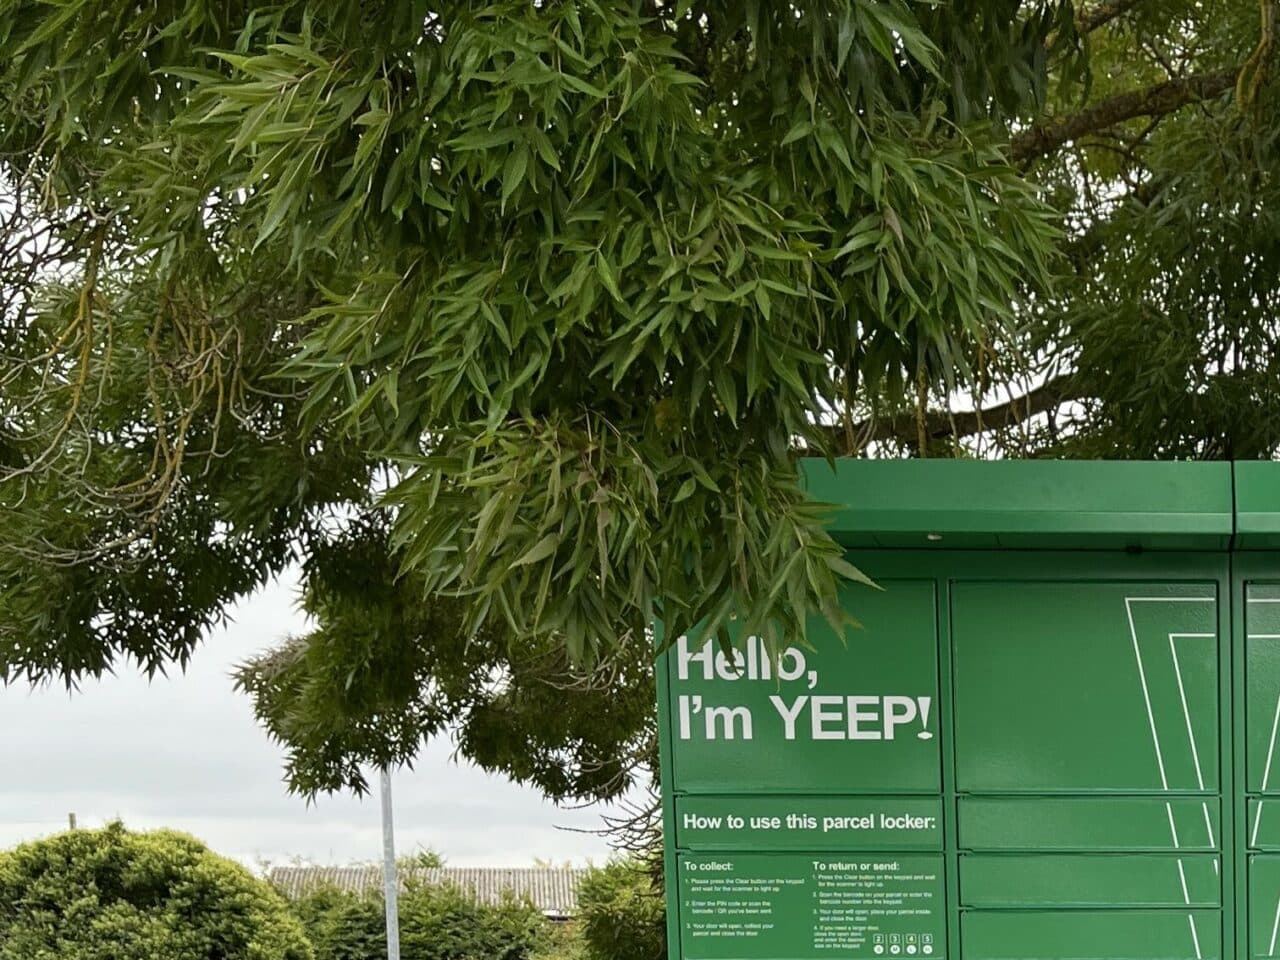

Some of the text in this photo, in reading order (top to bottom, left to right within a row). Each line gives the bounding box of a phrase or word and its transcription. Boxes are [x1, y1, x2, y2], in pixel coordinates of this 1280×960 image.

[677, 635, 818, 689] Hello,
[679, 696, 934, 740] I'm YEEP!
[684, 814, 936, 833] How to use this parcel locker:
[685, 862, 734, 871] To collect:
[813, 862, 826, 870] To
[829, 862, 857, 870] return
[873, 862, 900, 870] send:
